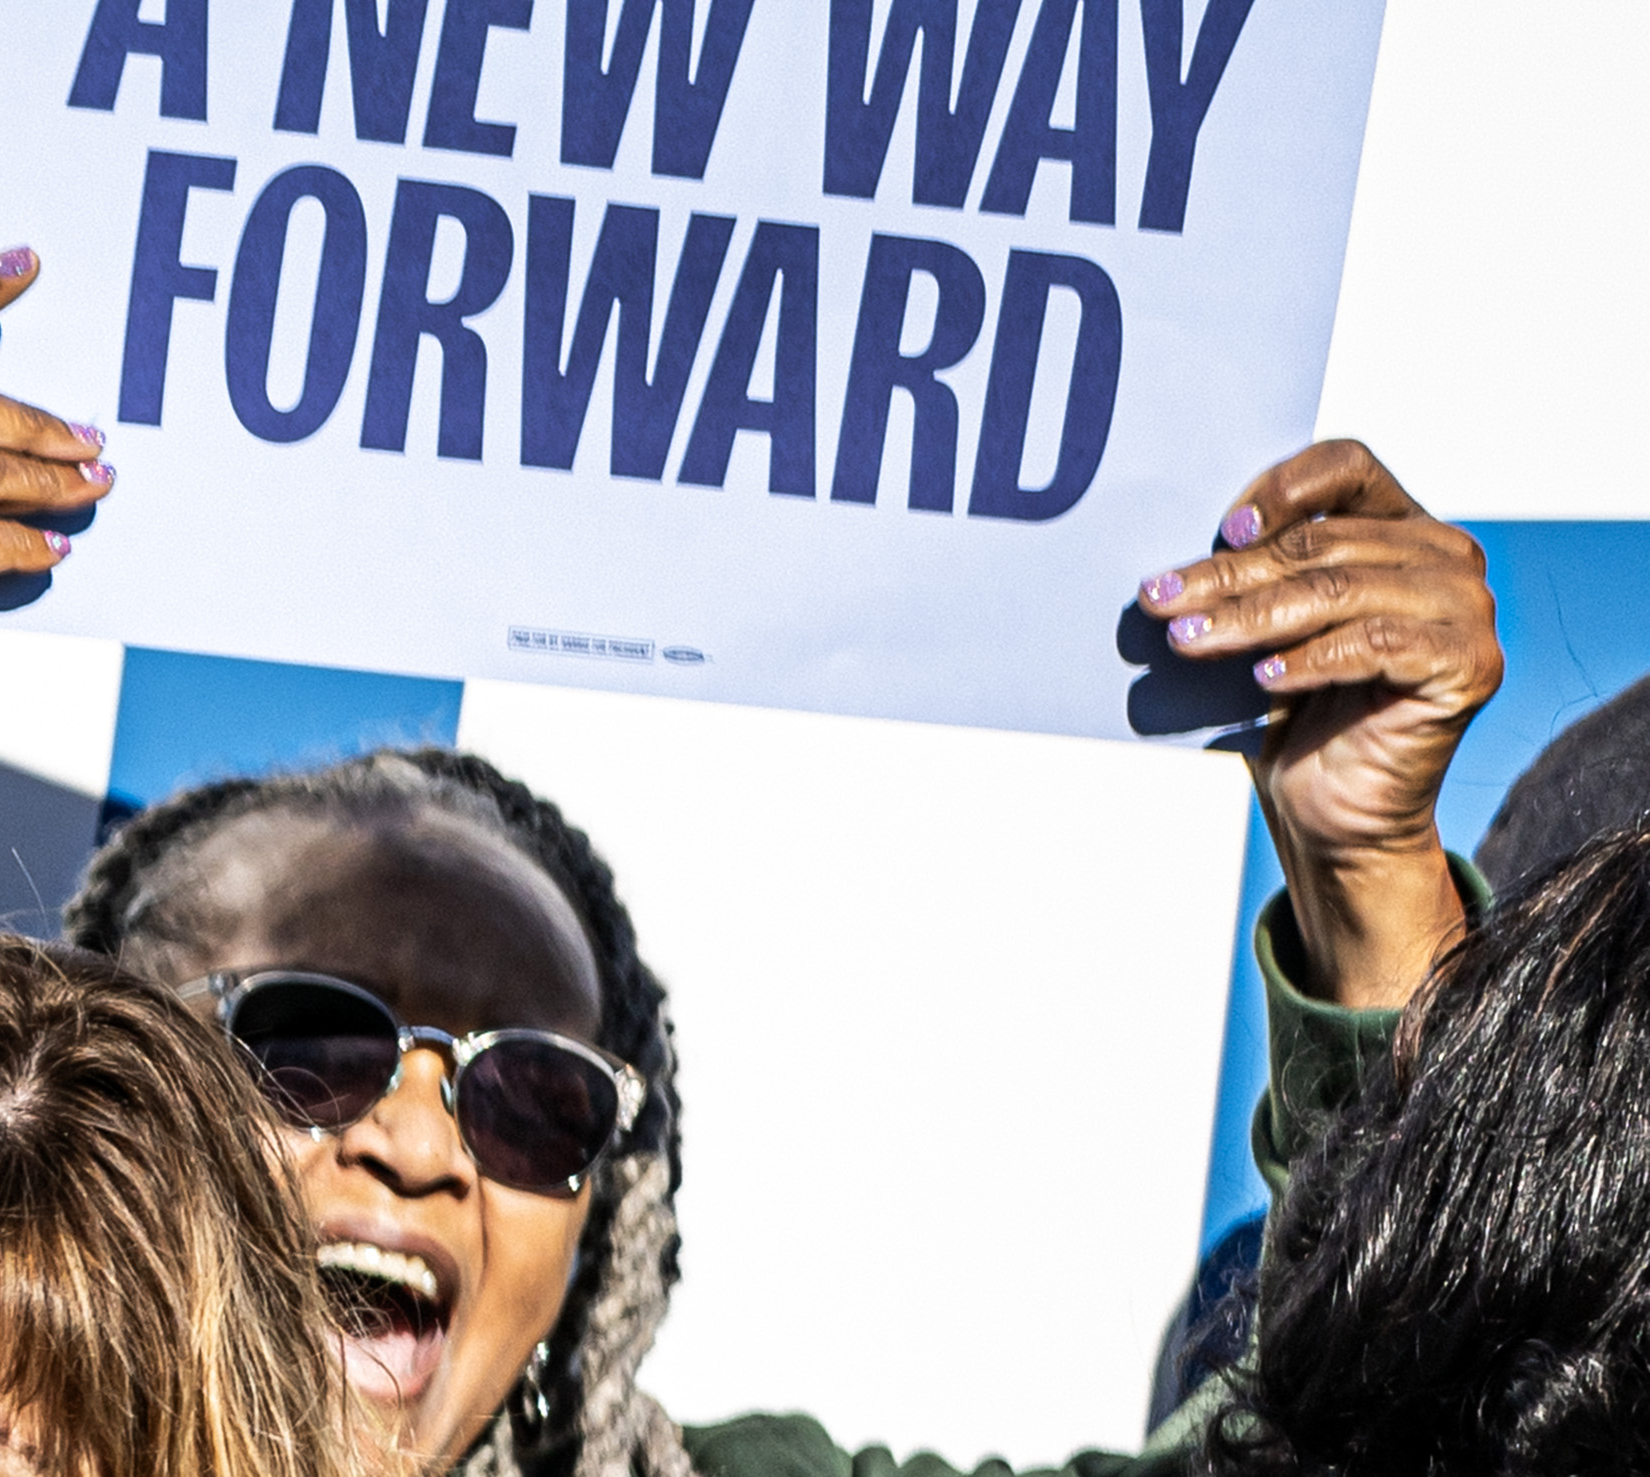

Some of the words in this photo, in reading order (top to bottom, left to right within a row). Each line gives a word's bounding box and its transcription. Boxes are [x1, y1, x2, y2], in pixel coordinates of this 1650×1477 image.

[272, 0, 755, 181] NEW
[822, 0, 1255, 235] WAY
[117, 148, 1123, 523] FORWARD
